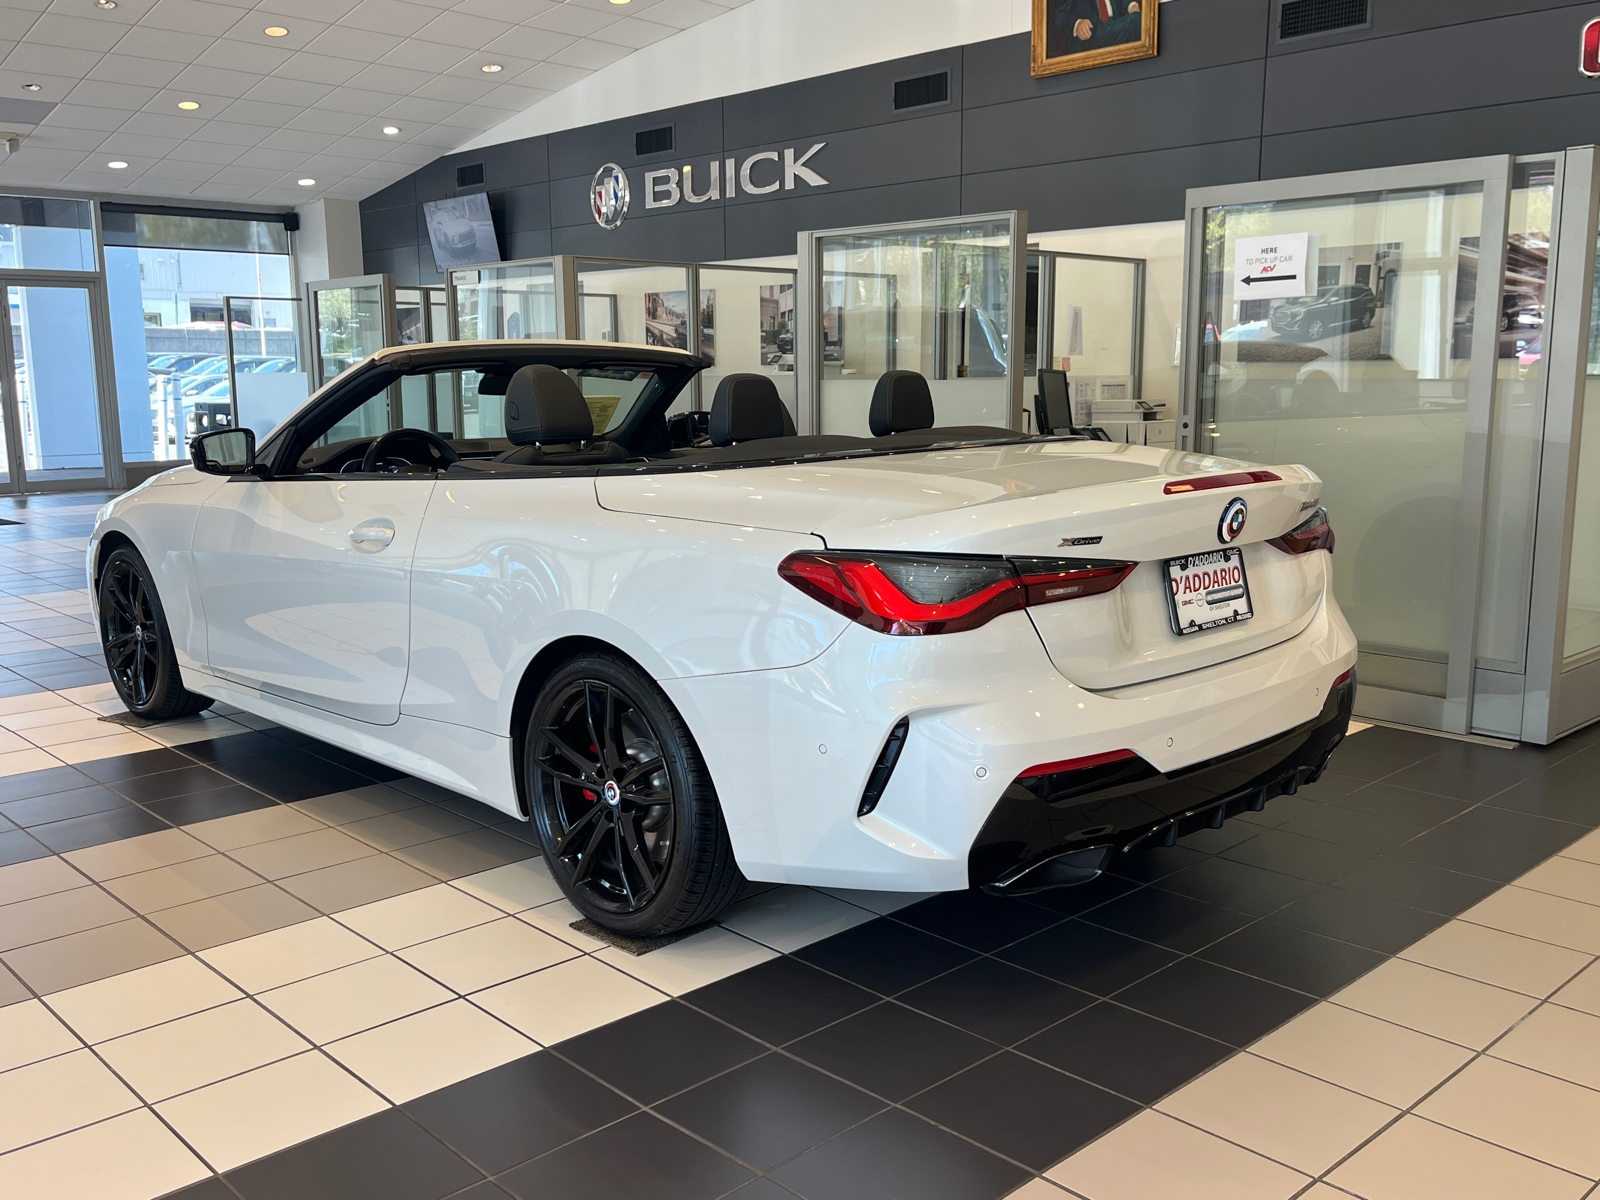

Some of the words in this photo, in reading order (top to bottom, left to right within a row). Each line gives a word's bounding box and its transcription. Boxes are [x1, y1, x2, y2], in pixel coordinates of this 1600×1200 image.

[645, 142, 830, 209] BUICK
[1280, 255, 1293, 263] CAR
[1187, 551, 1224, 568] D'ADDARIO
[1226, 548, 1240, 556] GMC
[1171, 565, 1240, 596] D'ADDARIO
[1182, 598, 1194, 606] GMC
[1182, 625, 1199, 634] NISSAN
[1201, 618, 1227, 630] SHELTON,
